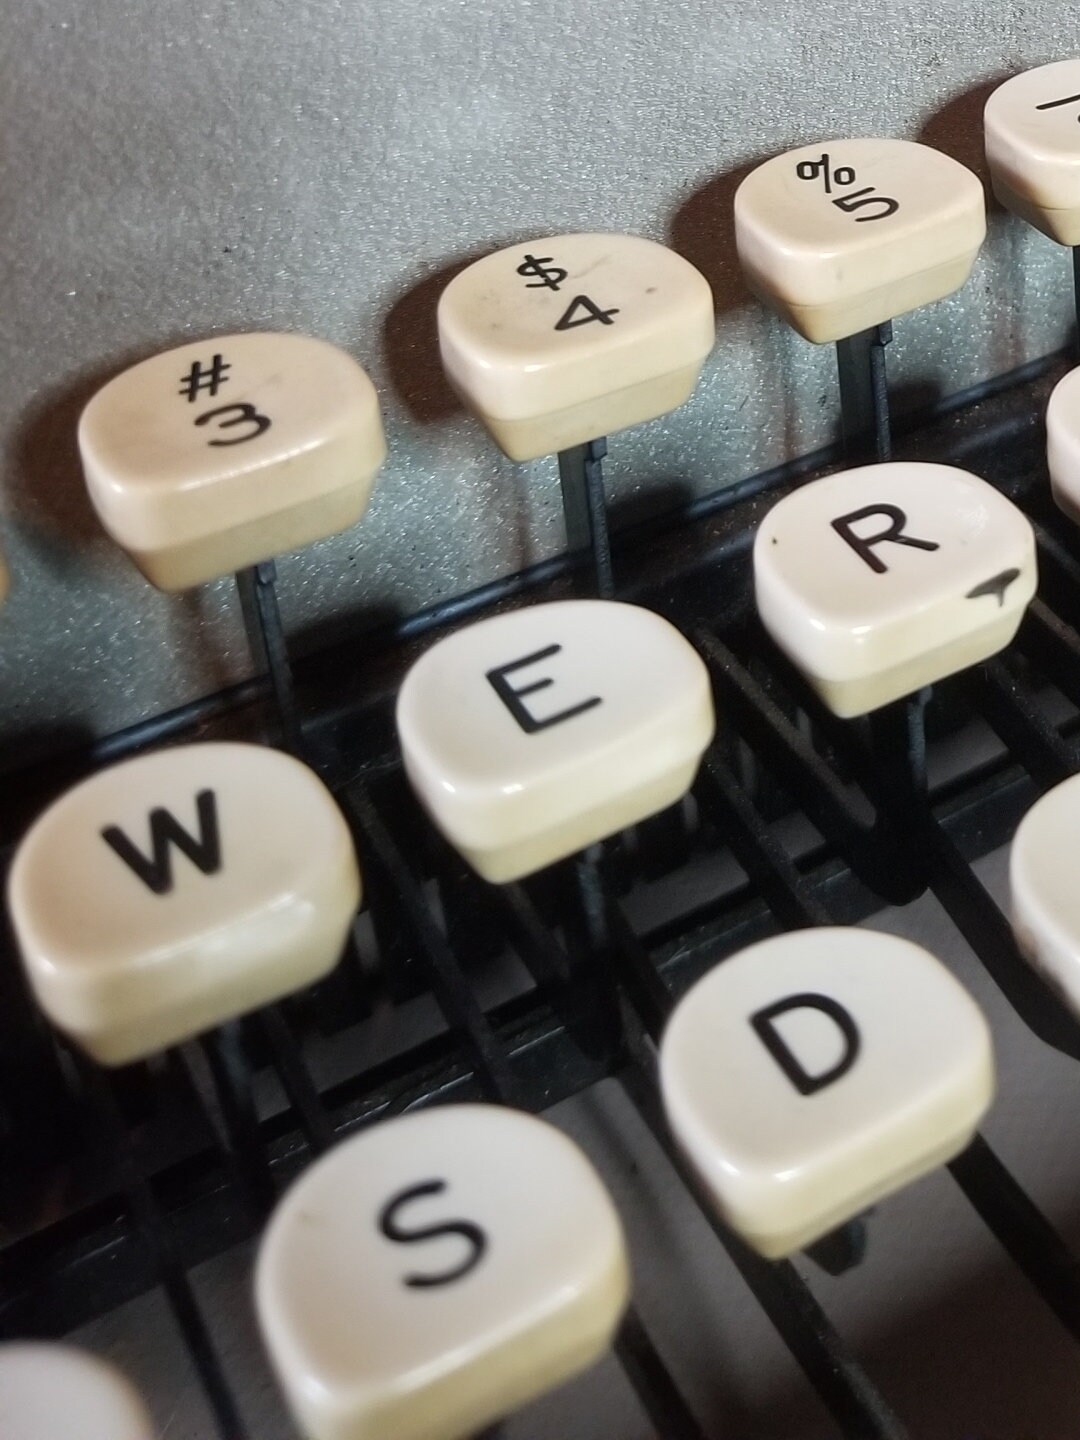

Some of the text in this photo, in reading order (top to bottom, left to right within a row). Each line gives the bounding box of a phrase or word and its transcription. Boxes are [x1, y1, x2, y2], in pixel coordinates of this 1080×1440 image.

[796, 153, 856, 193] %
[832, 186, 900, 223] 5
[516, 254, 568, 291] $
[553, 294, 619, 332] 4
[178, 354, 232, 402] #
[194, 403, 271, 448] 3
[830, 503, 940, 575] R
[484, 643, 603, 736] E
[100, 788, 223, 897] W
[748, 992, 862, 1098] D
[376, 1179, 488, 1292] S
